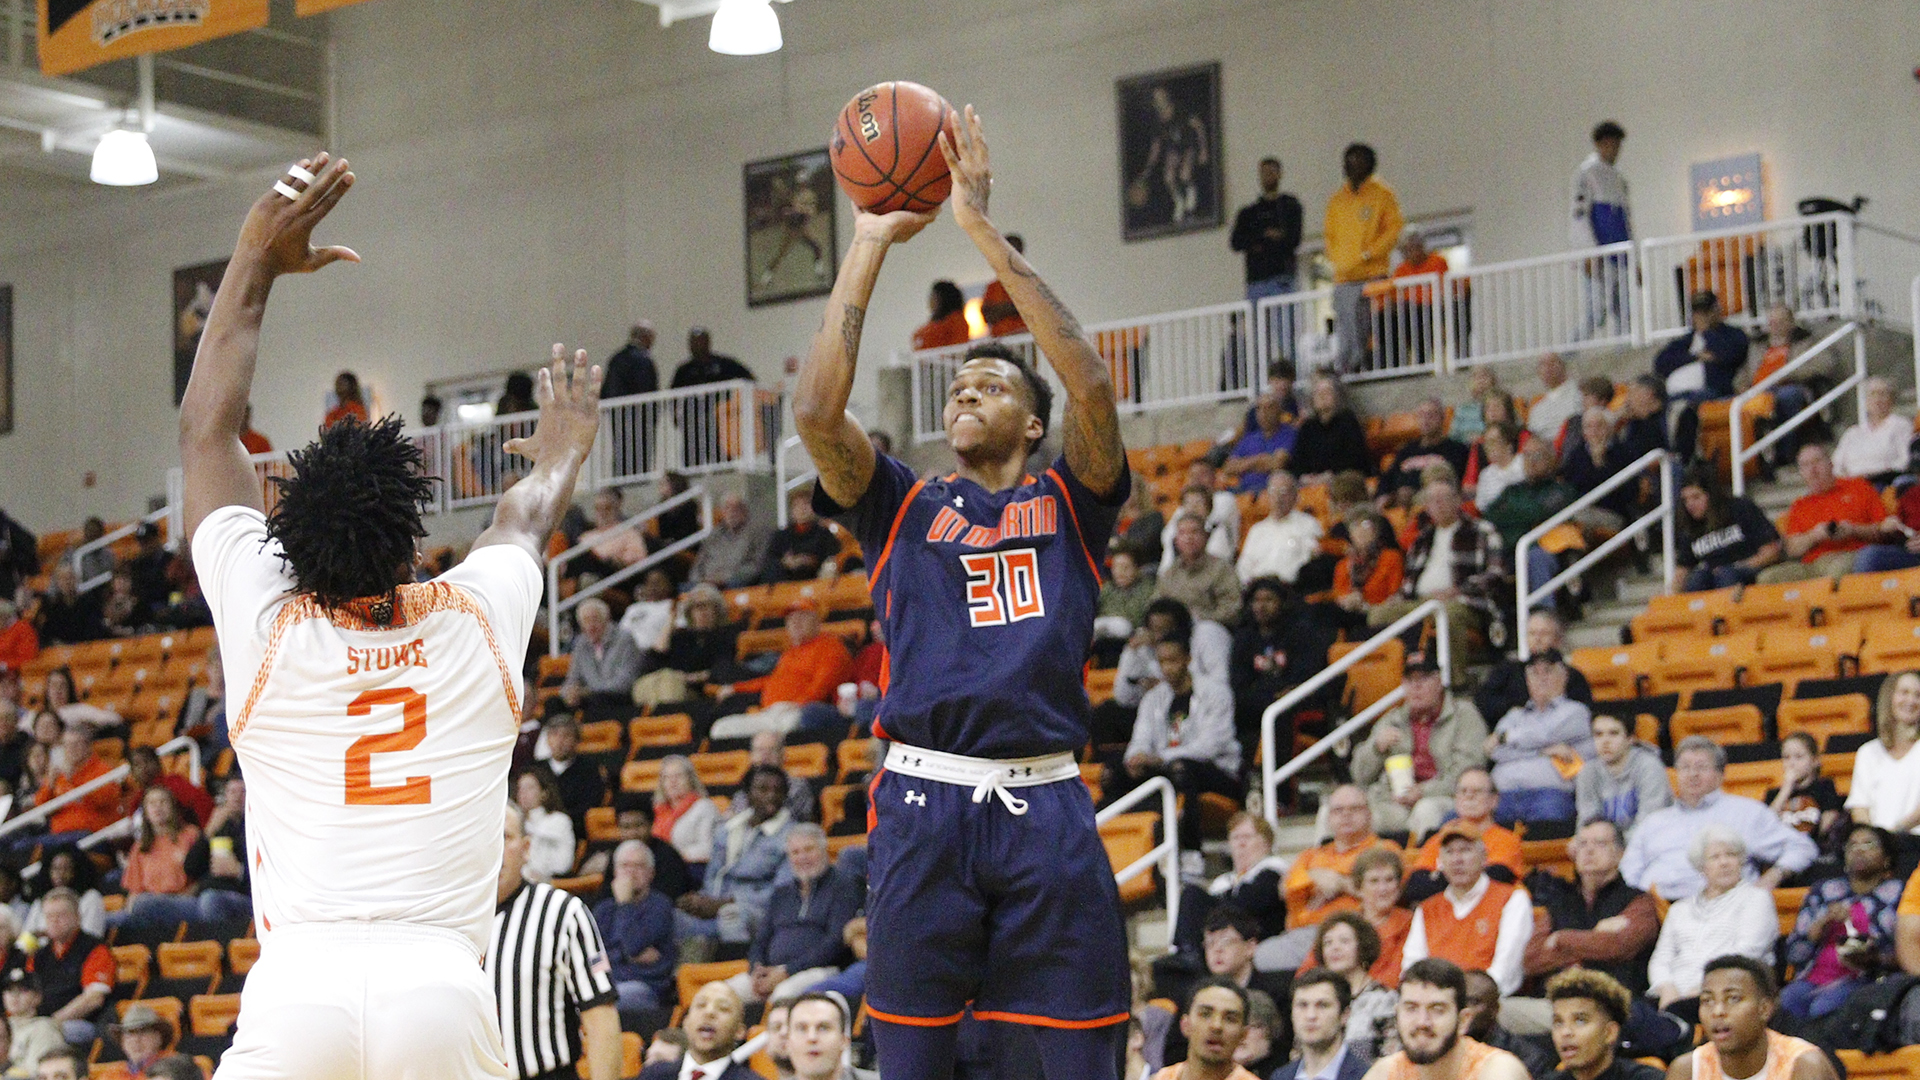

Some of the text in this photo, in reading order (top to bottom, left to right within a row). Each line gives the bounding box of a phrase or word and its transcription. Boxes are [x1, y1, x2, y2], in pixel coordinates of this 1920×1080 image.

[858, 89, 881, 145] lson
[926, 505, 970, 542] UT
[959, 548, 1045, 628] 30
[347, 638, 428, 675] STOWE
[344, 686, 431, 805] 2
